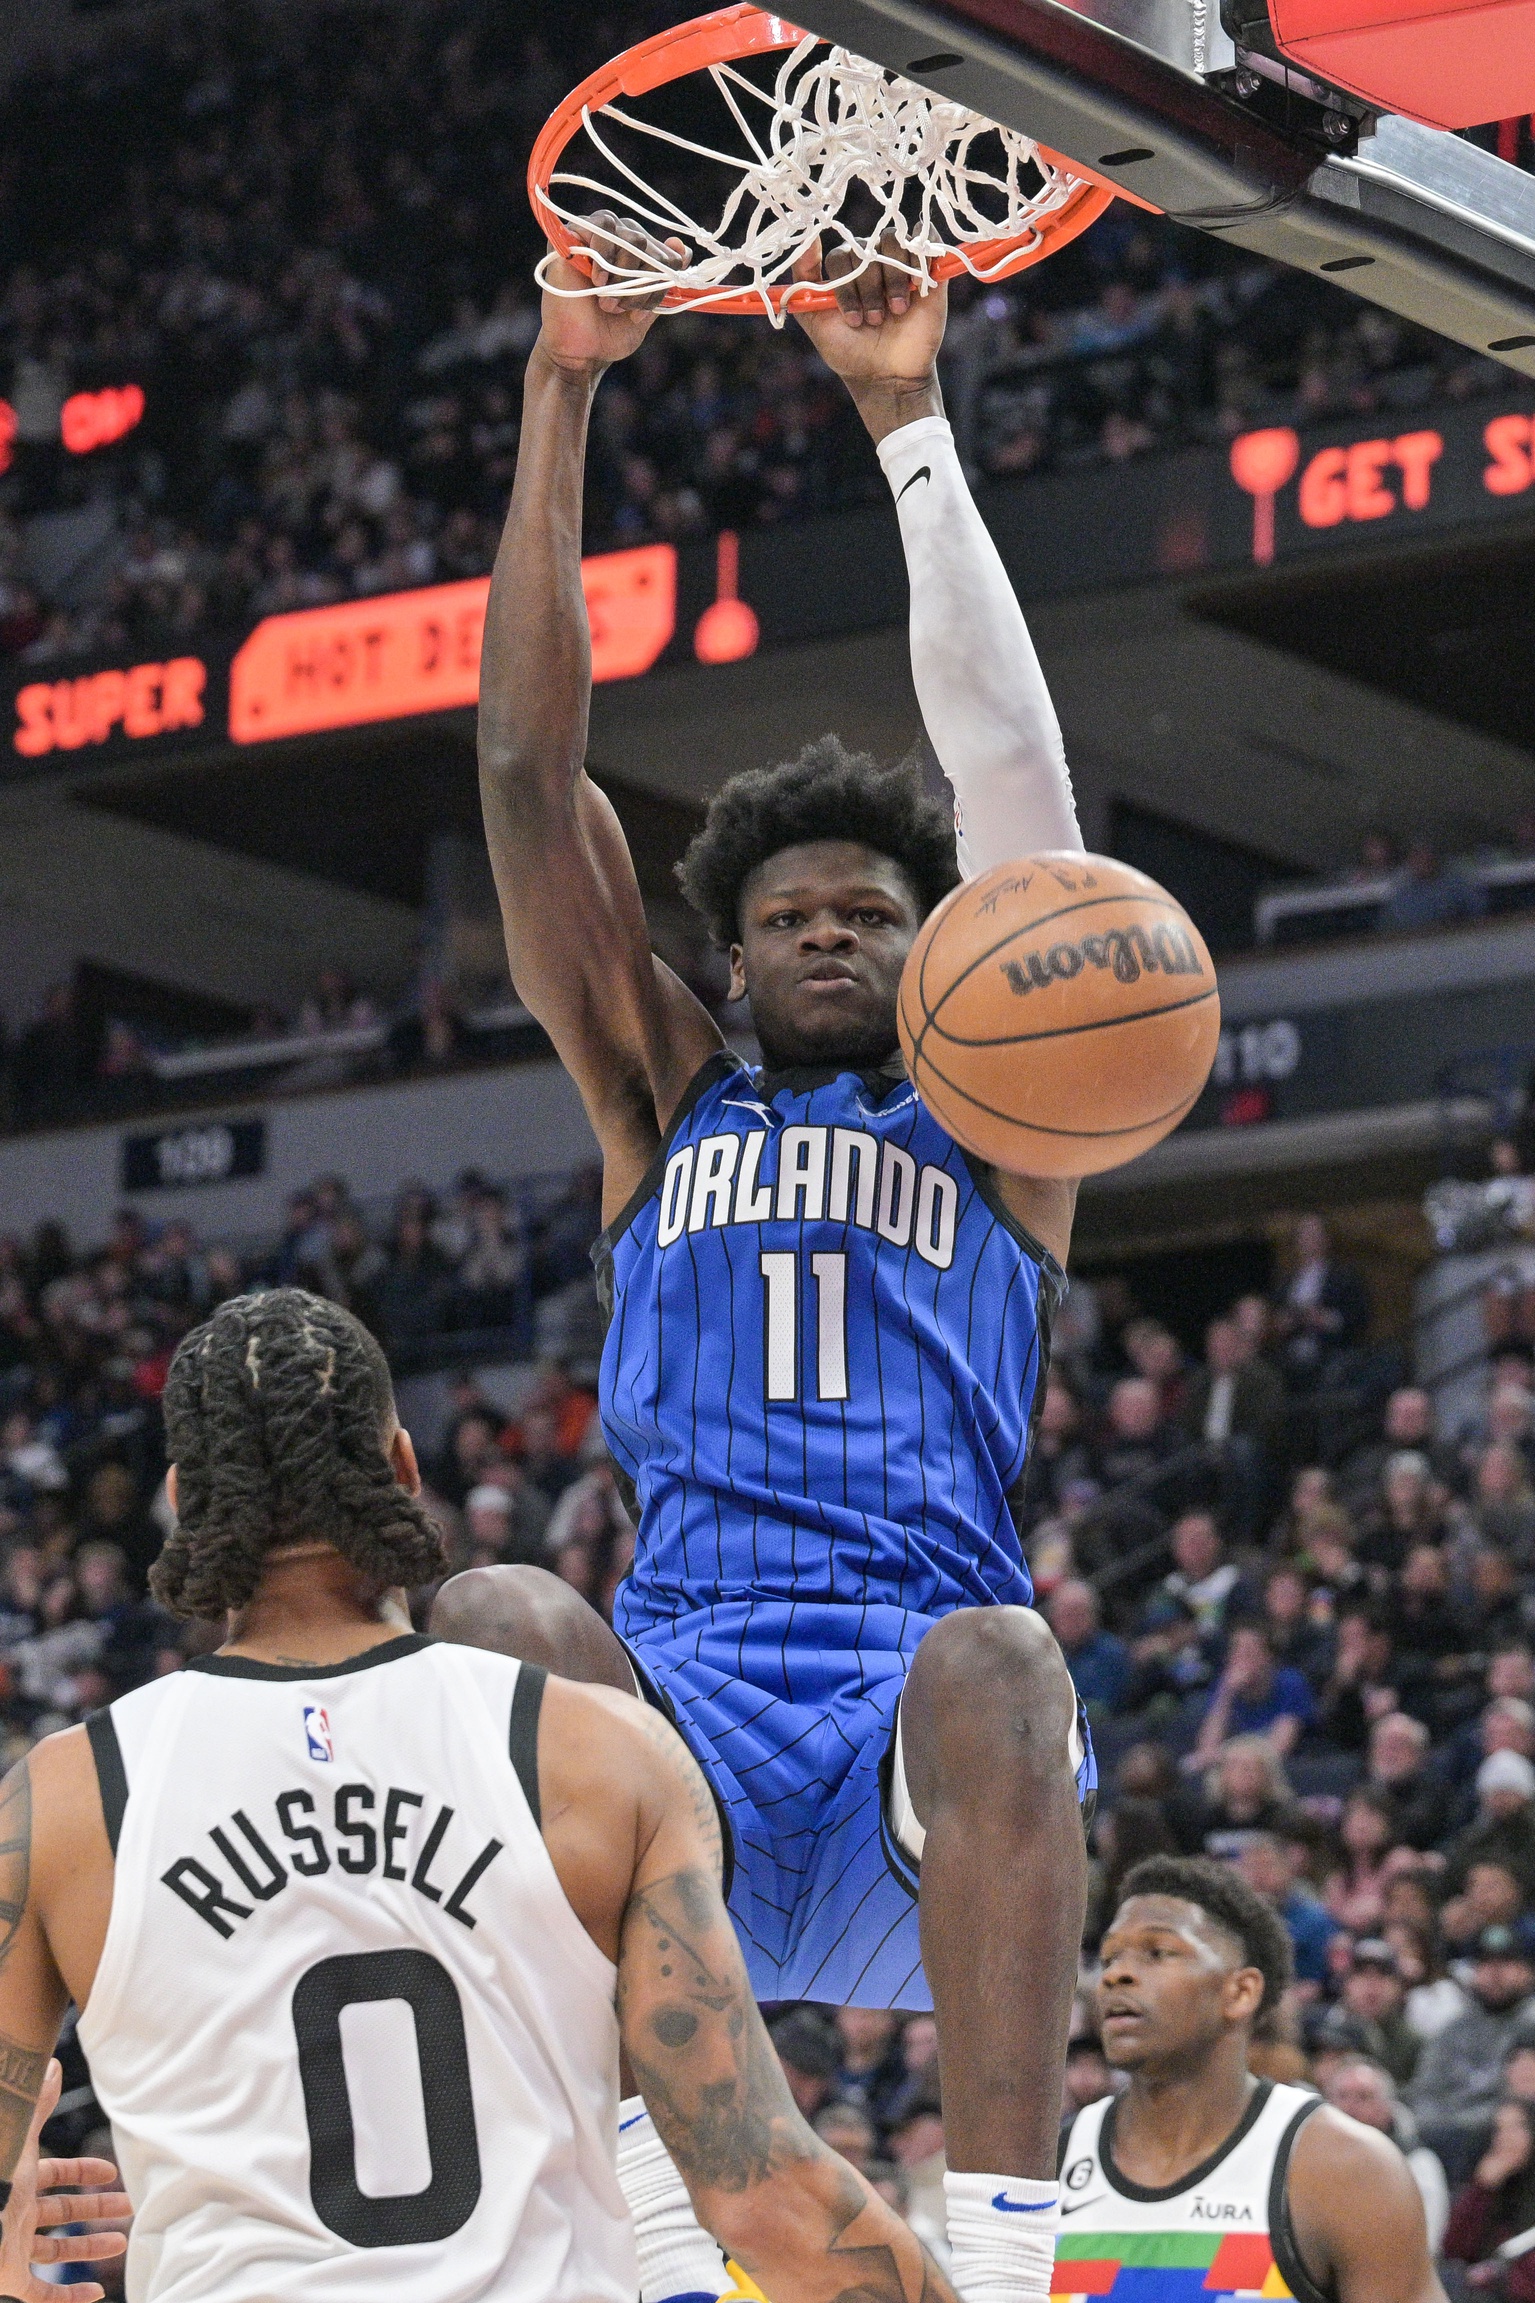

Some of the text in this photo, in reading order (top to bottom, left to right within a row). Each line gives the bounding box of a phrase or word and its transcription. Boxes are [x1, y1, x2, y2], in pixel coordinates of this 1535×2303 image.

[1299, 429, 1444, 528] GET
[13, 656, 207, 757] SUPER
[1000, 922, 1204, 997] Wilson
[656, 1124, 959, 1271] ORLANDO
[759, 1250, 850, 1403] 11
[160, 1782, 504, 1941] RUSSELL
[291, 1947, 483, 2248] 0
